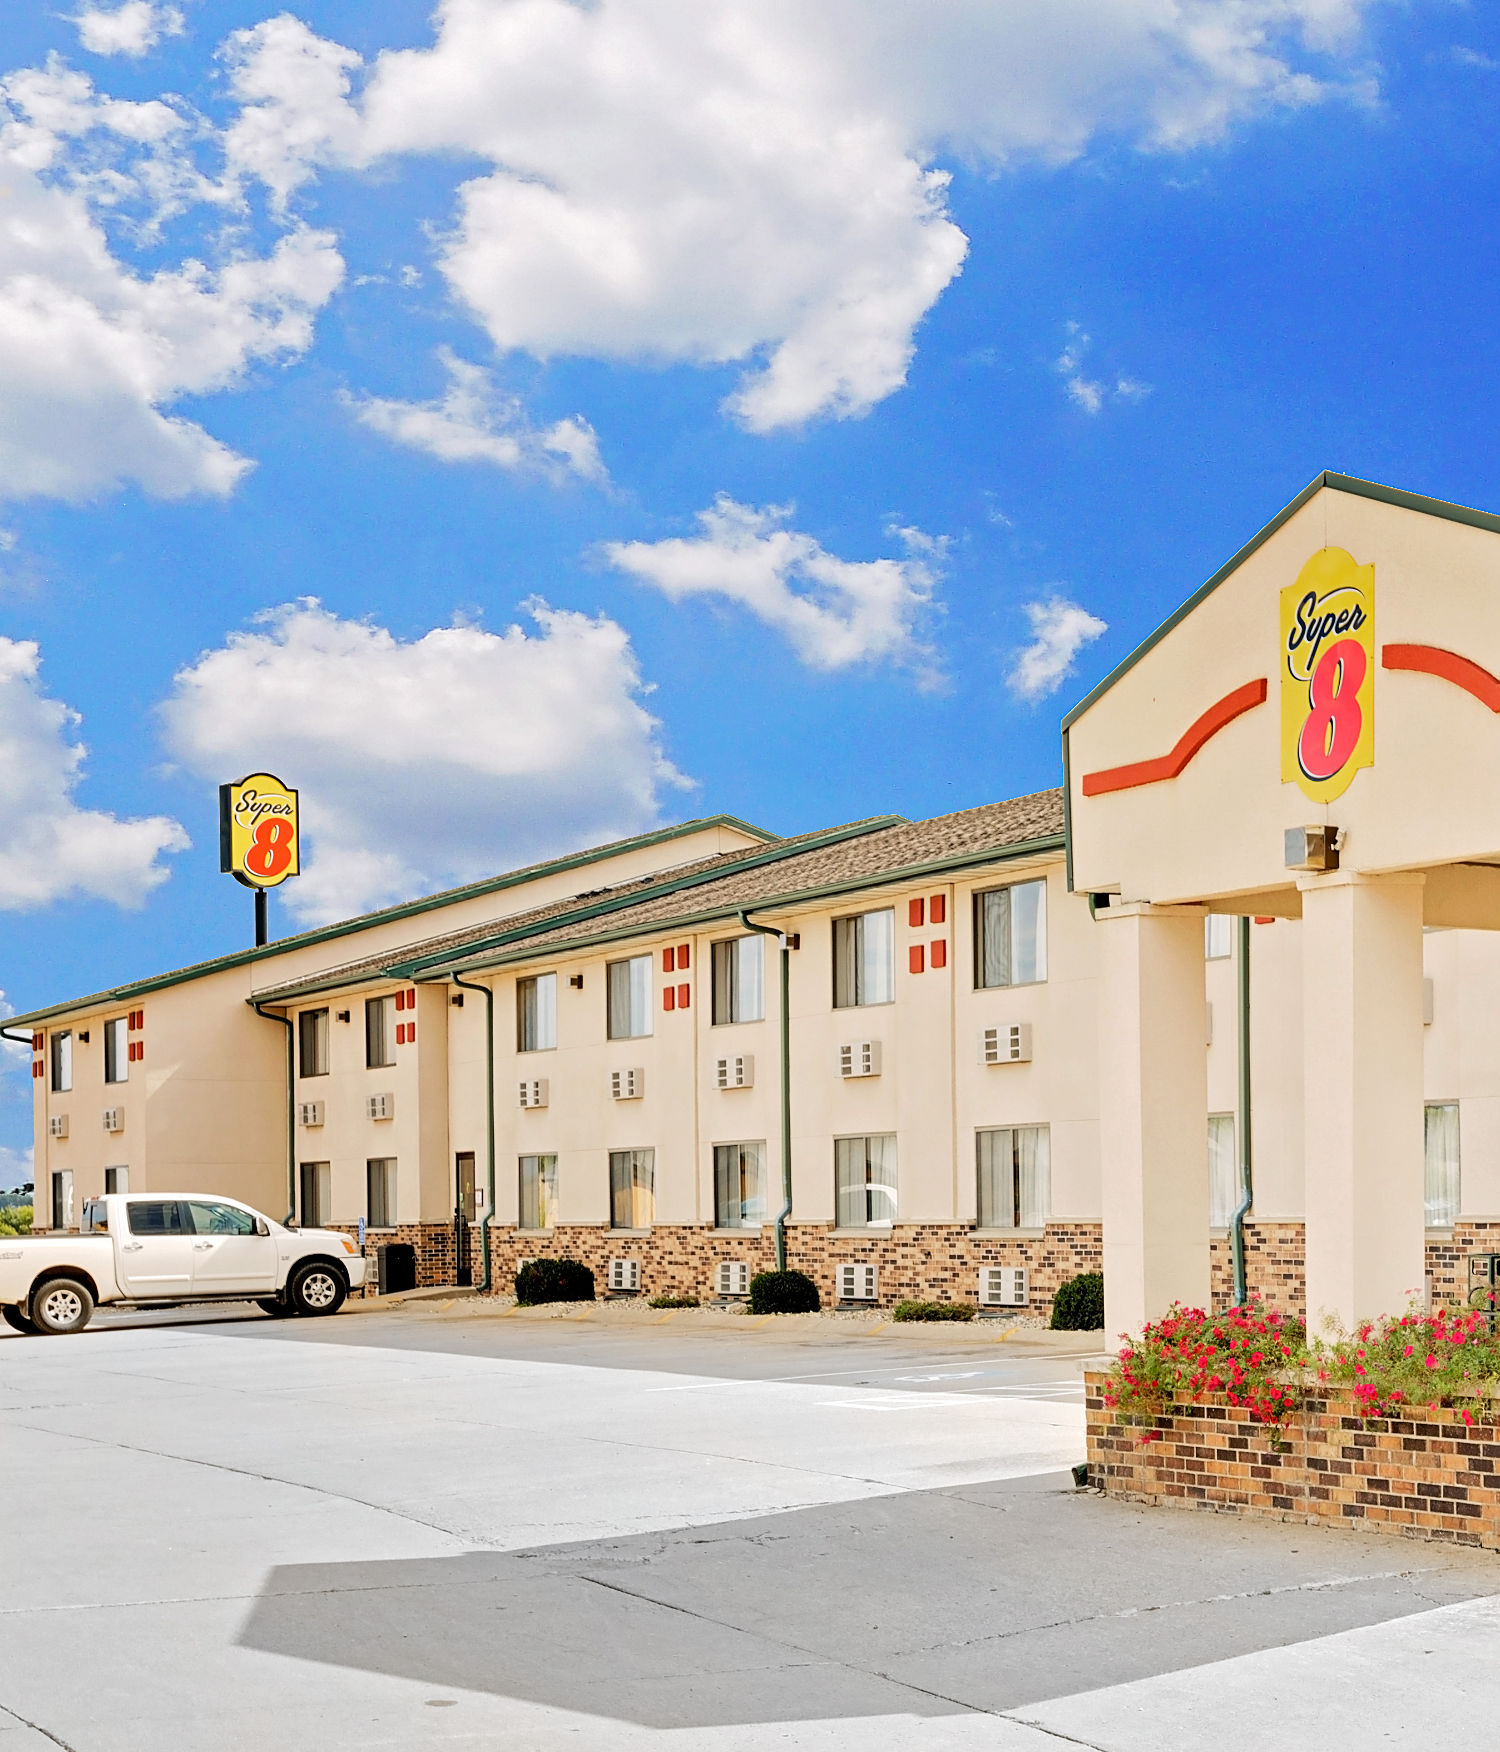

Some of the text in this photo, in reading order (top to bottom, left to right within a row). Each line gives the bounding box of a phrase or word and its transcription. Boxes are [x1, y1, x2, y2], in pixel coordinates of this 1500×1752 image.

[1287, 590, 1367, 672] Super
[1297, 638, 1367, 782] 8
[235, 789, 294, 826] Super
[243, 817, 294, 877] 8
